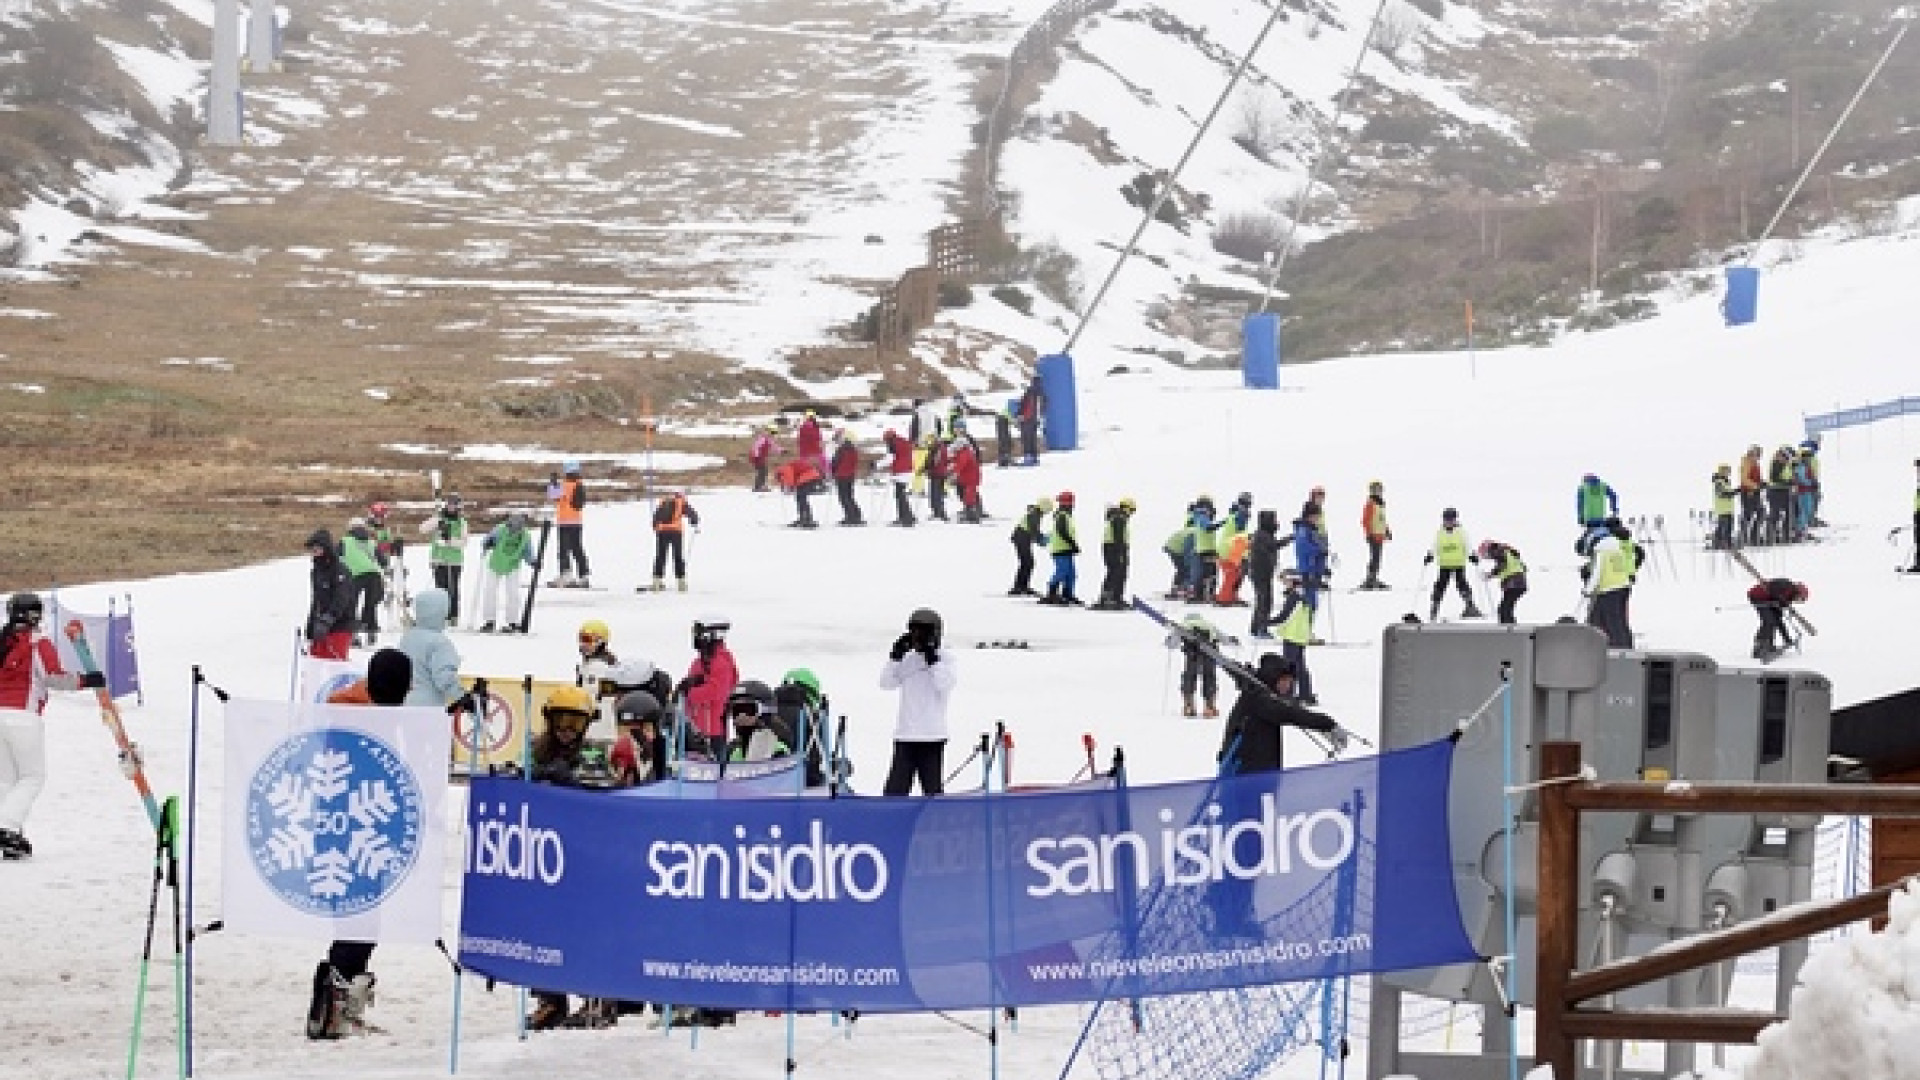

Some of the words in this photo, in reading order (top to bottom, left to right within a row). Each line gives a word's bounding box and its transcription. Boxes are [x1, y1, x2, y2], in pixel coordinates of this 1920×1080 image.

[314, 810, 349, 836] 50
[476, 801, 565, 885] isidro
[1026, 831, 1150, 897] san
[1158, 792, 1355, 887] isidro
[645, 839, 731, 900] san
[733, 818, 889, 902] isidro
[642, 959, 900, 986] www.nieveleonsanisidro.com
[1027, 932, 1372, 983] www.nieveleonsanisidro.com
